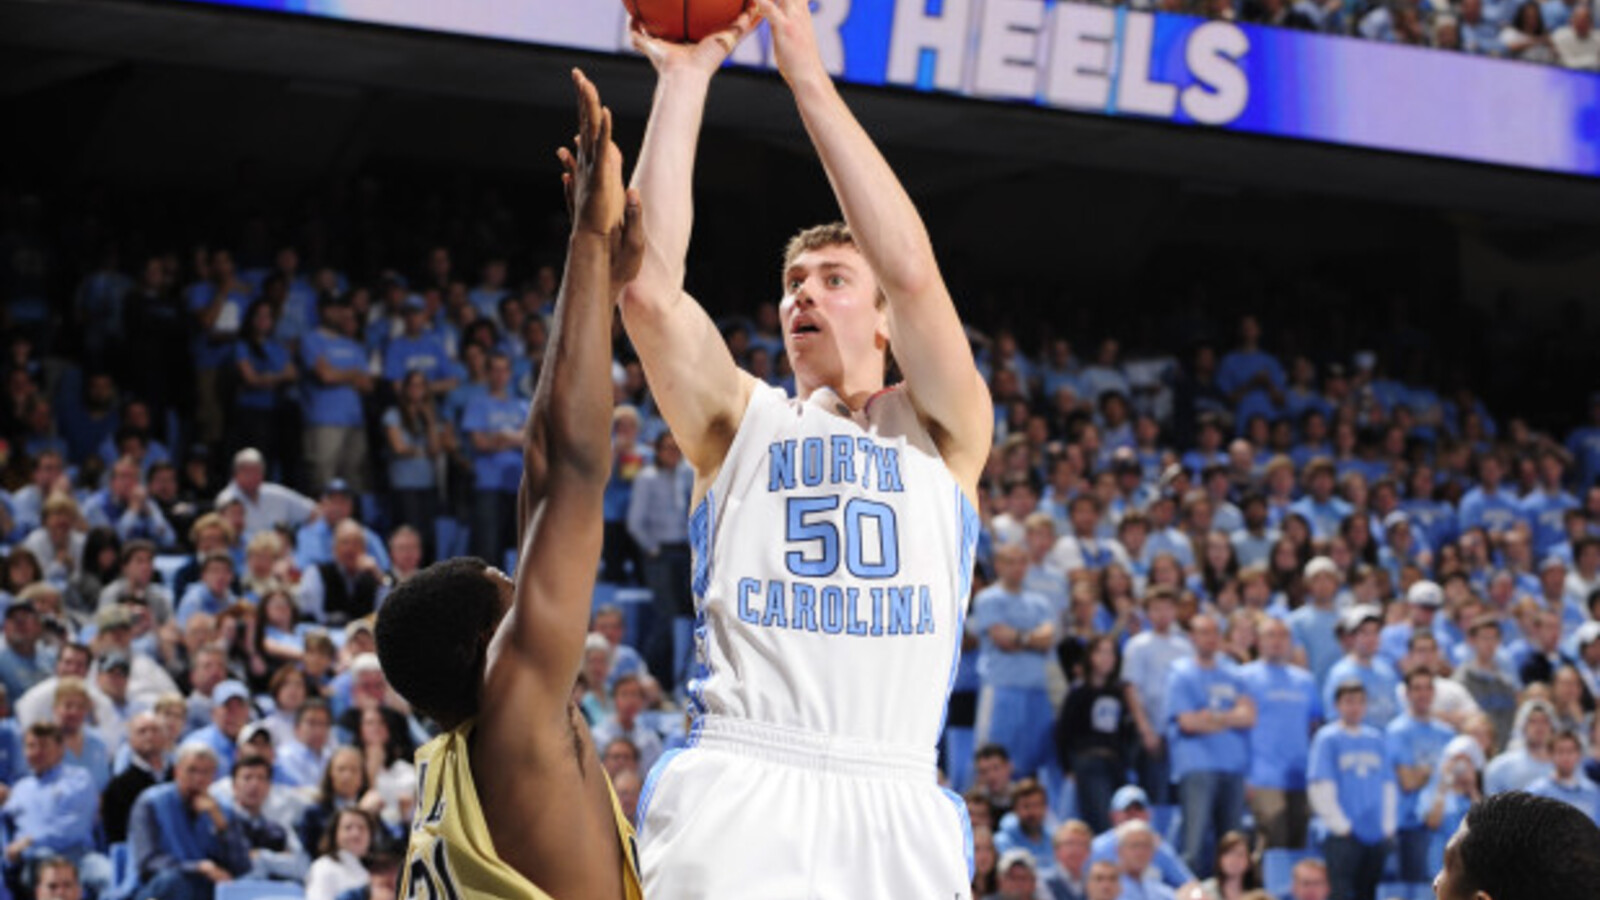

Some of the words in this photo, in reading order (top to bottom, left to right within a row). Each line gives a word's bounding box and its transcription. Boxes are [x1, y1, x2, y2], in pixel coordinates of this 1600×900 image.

[886, 0, 1250, 126] HEELS
[768, 434, 904, 492] NORTH
[785, 494, 899, 579] 50
[737, 576, 935, 636] CAROLINA
